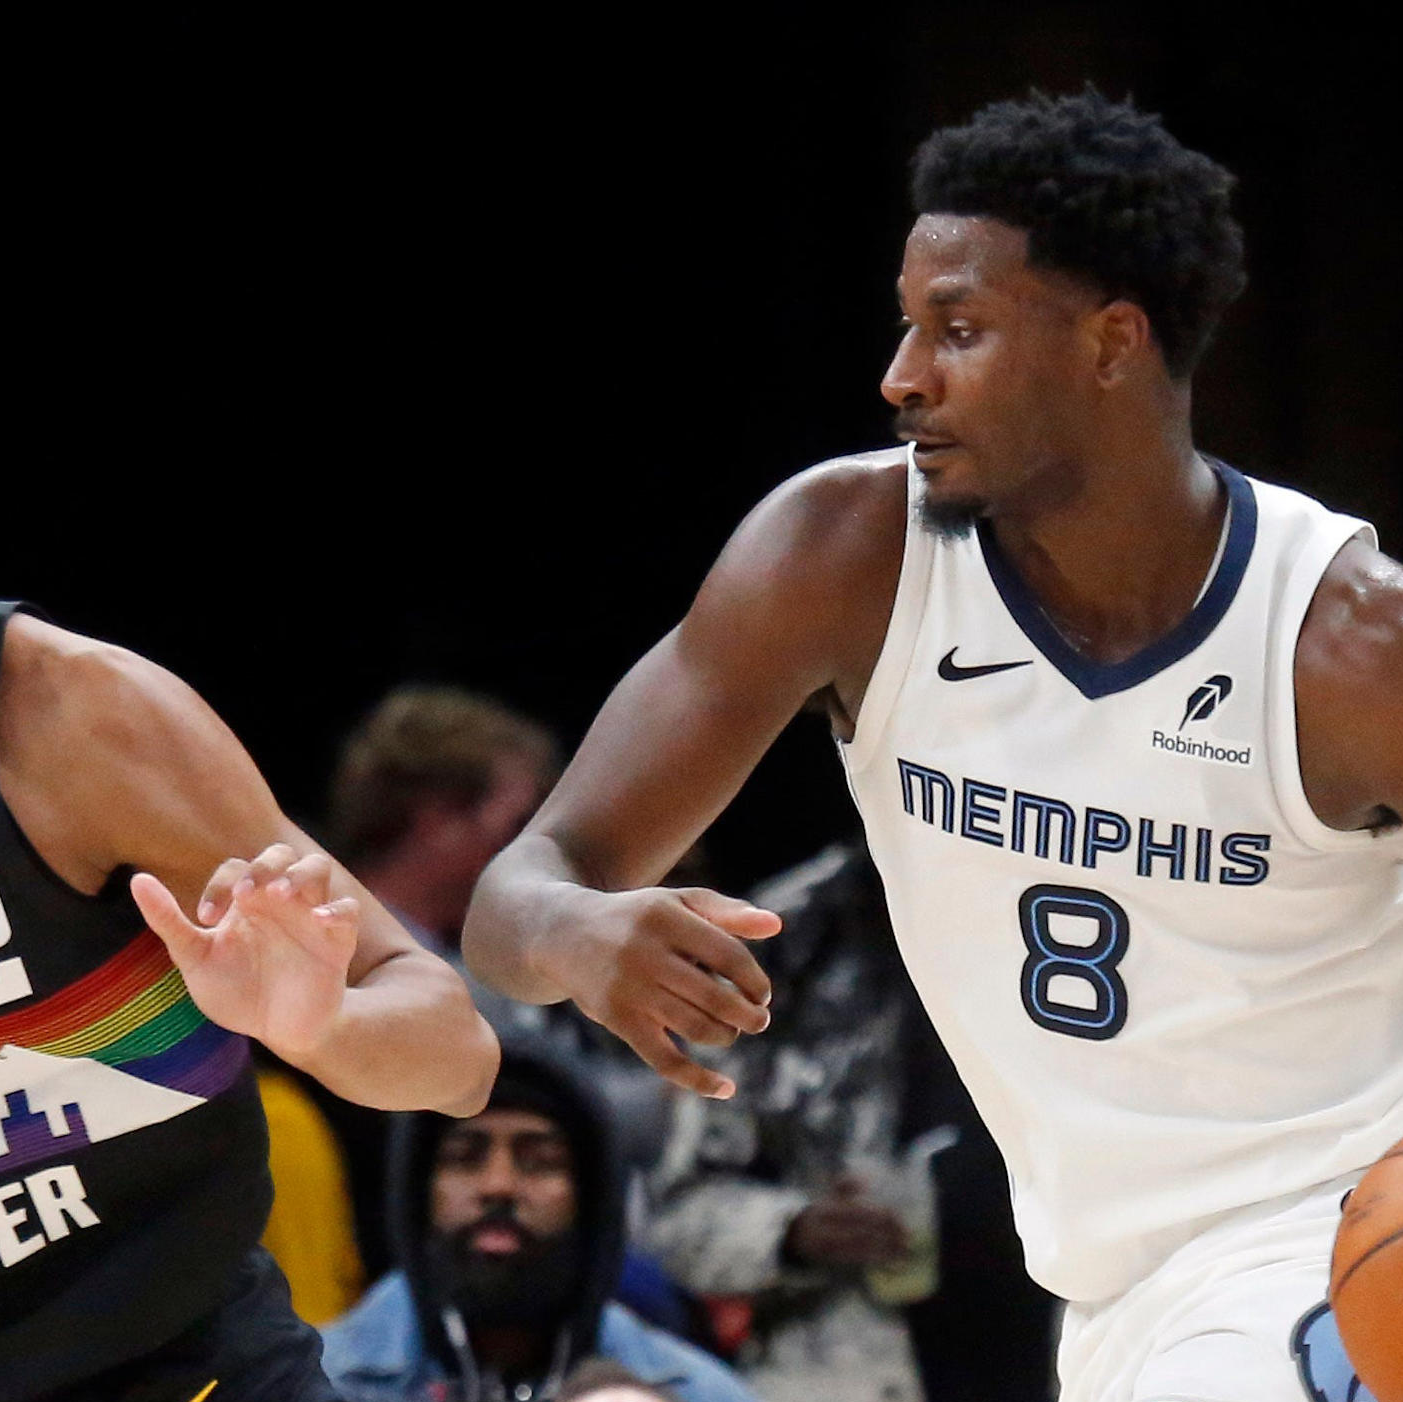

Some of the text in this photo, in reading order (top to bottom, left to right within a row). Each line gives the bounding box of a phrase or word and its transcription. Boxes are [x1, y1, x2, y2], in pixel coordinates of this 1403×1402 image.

[1152, 729, 1251, 765] Robinhood
[897, 757, 1271, 887] MEMPHIS
[1018, 883, 1130, 1041] 8
